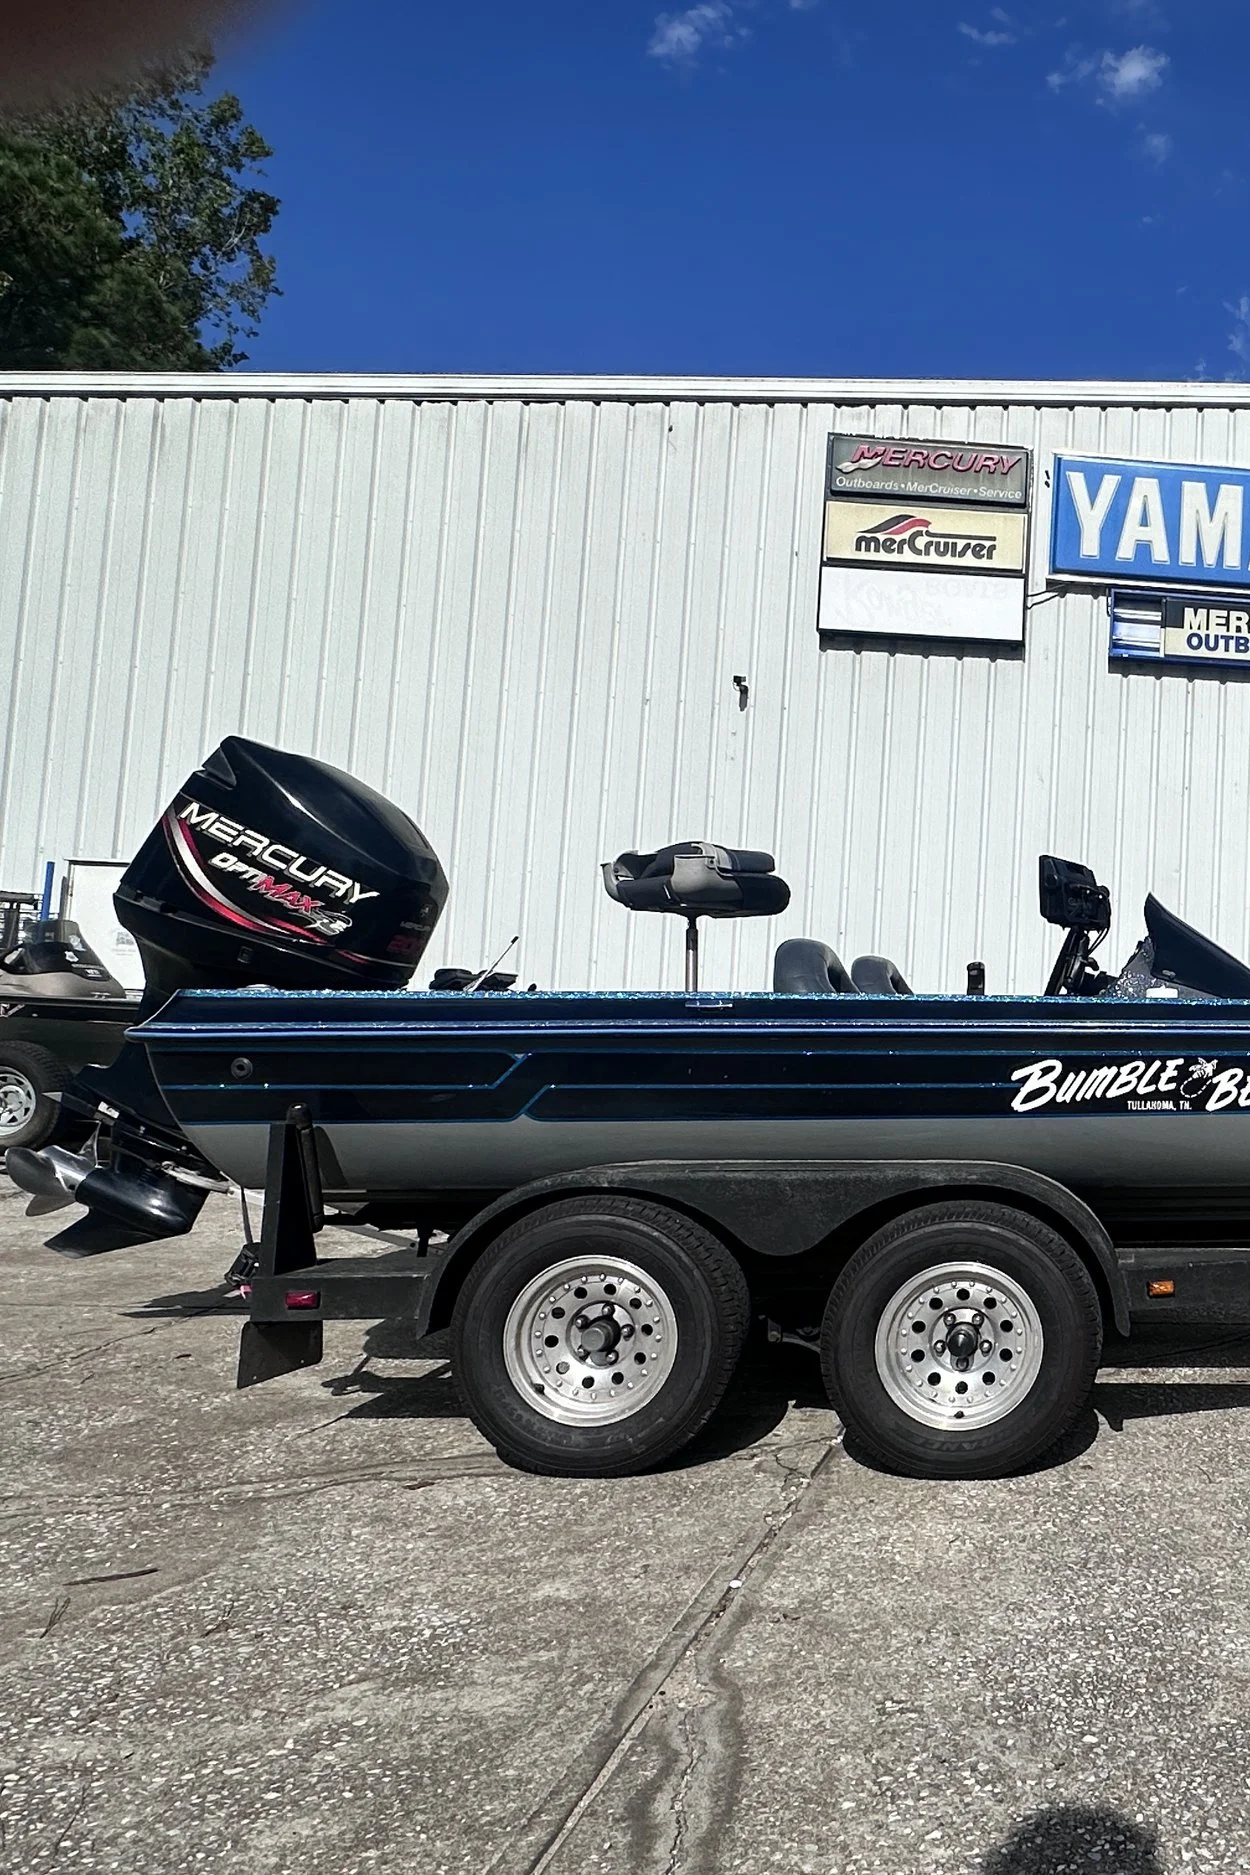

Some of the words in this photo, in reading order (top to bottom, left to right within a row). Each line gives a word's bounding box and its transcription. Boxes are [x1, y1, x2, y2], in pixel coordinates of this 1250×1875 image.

[848, 444, 1022, 475] MERCURY
[978, 486, 1022, 500] Service
[179, 802, 380, 905] MERCURY
[1010, 1058, 1184, 1112] BUMBLE
